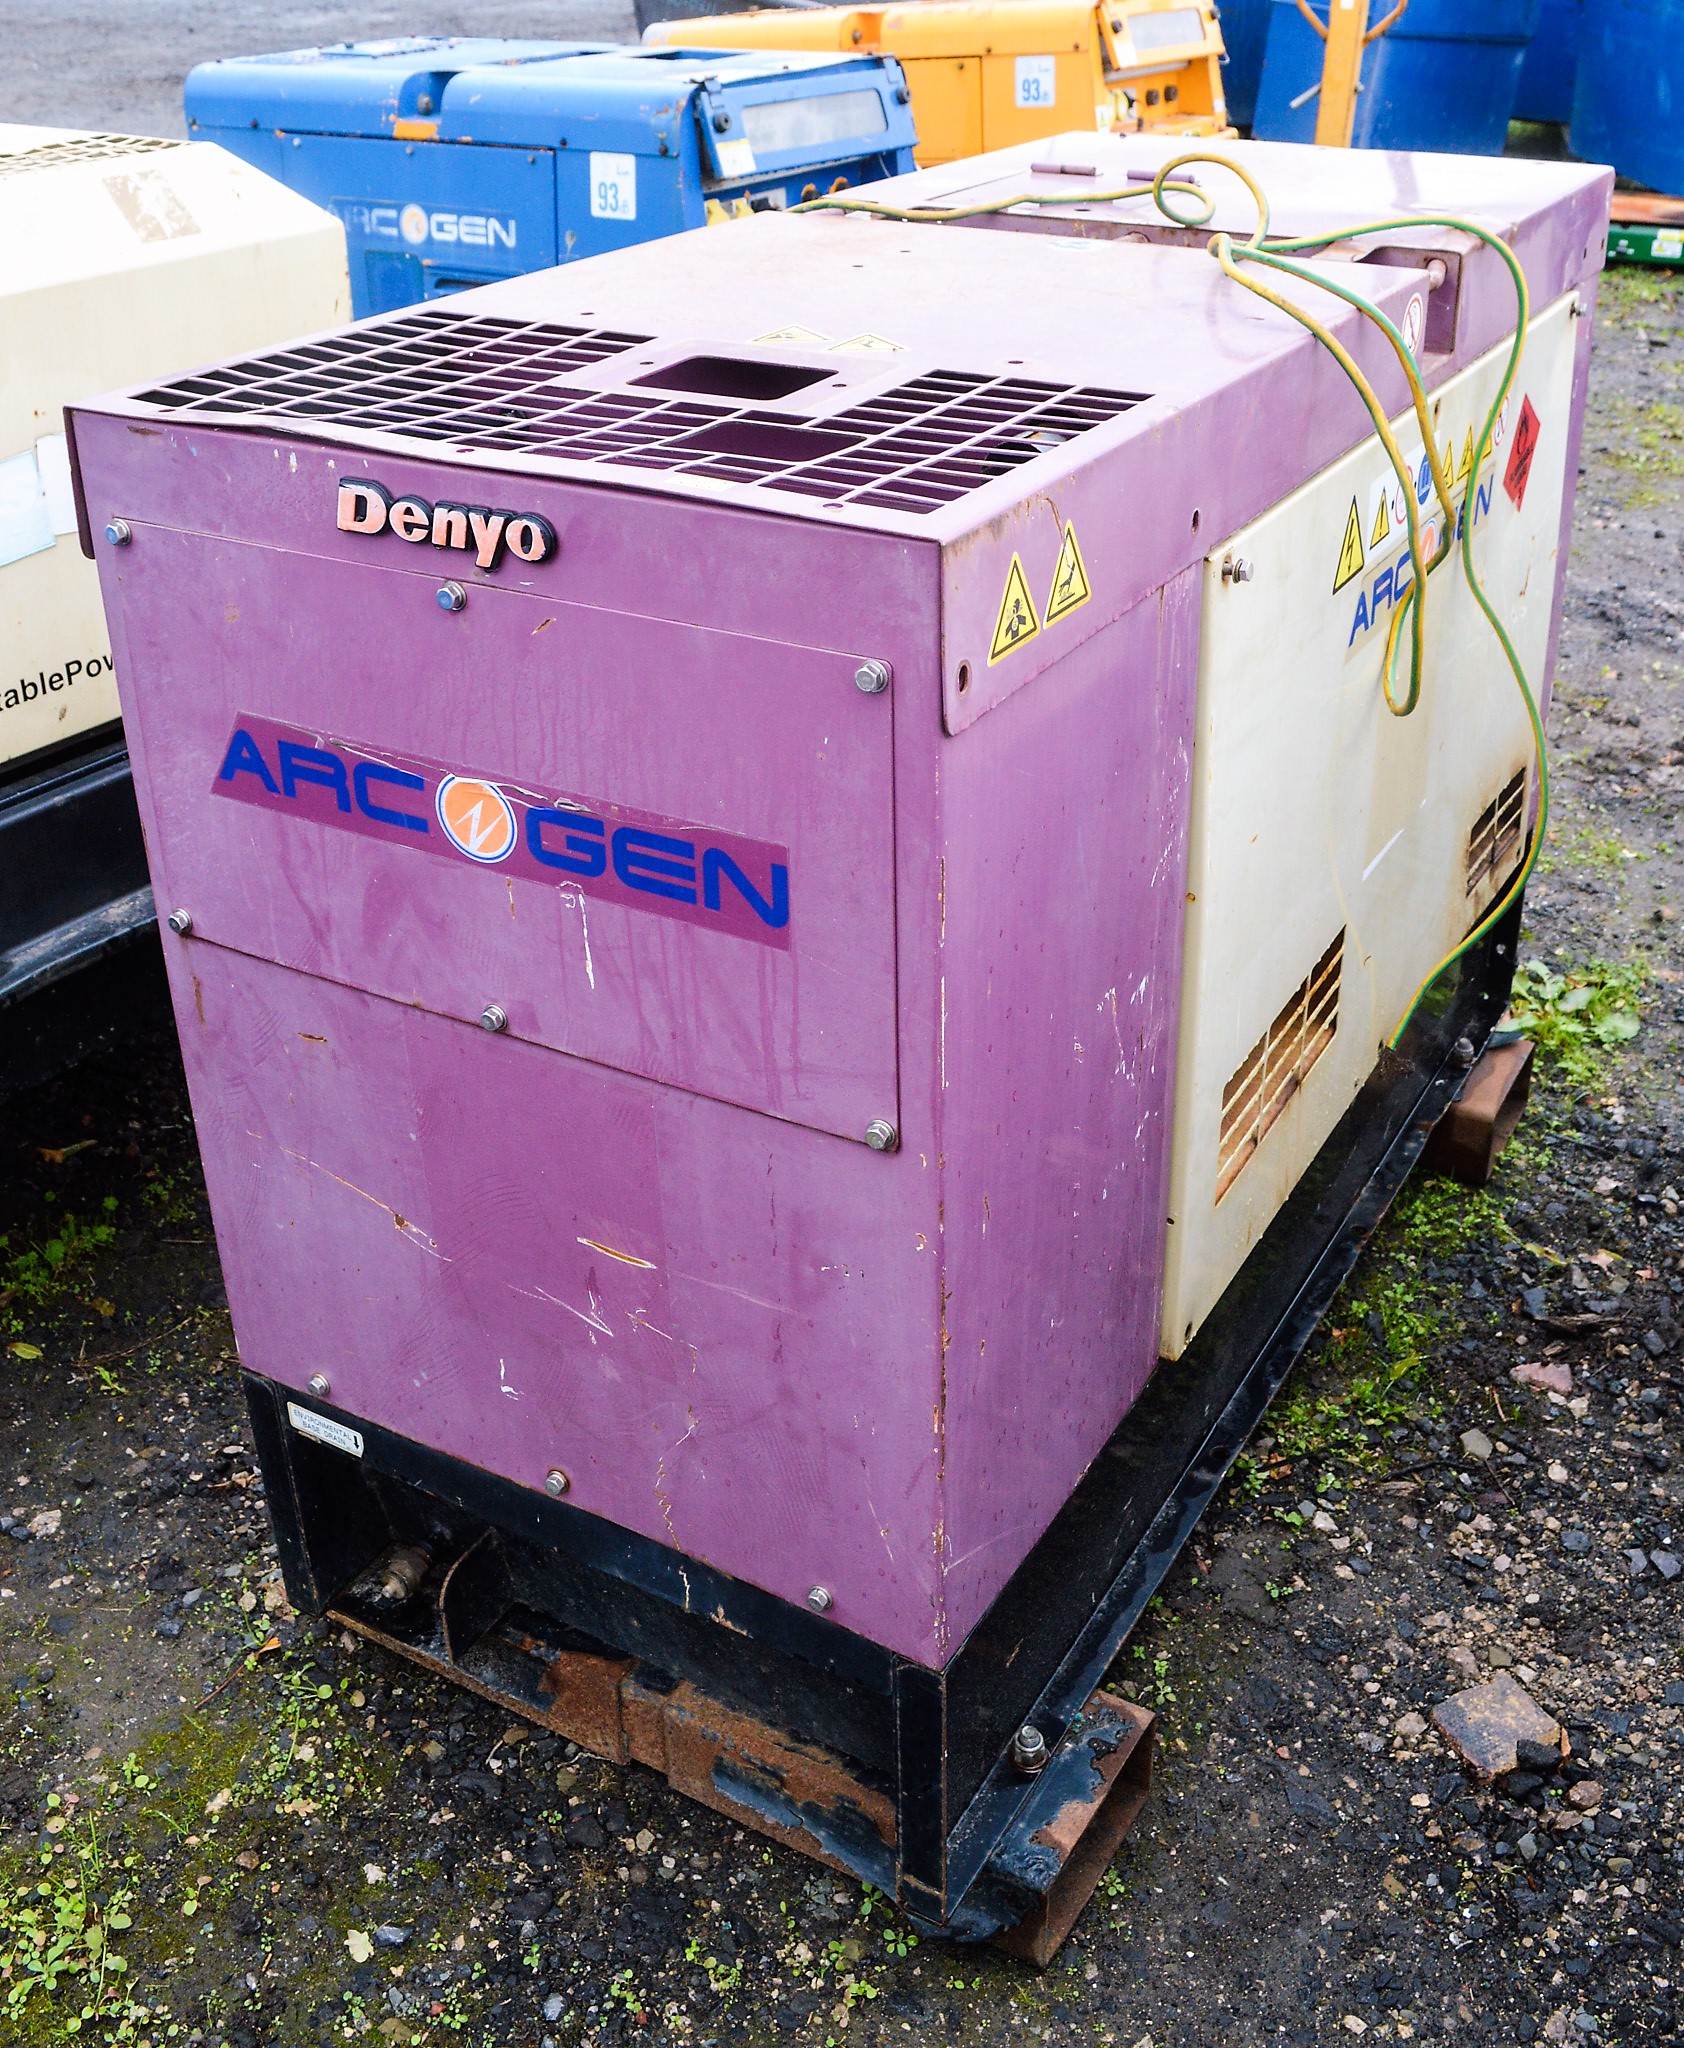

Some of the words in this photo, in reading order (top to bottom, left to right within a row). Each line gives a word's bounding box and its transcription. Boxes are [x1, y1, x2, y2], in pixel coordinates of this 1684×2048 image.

[1022, 78, 1040, 101] 93
[598, 182, 619, 211] 93
[336, 478, 556, 572] Denyo
[0, 653, 113, 711] ablePo
[293, 1408, 353, 1441] ENVIRONMENTAL
[302, 1420, 321, 1434] BASE
[323, 1430, 347, 1446] DRAIN
